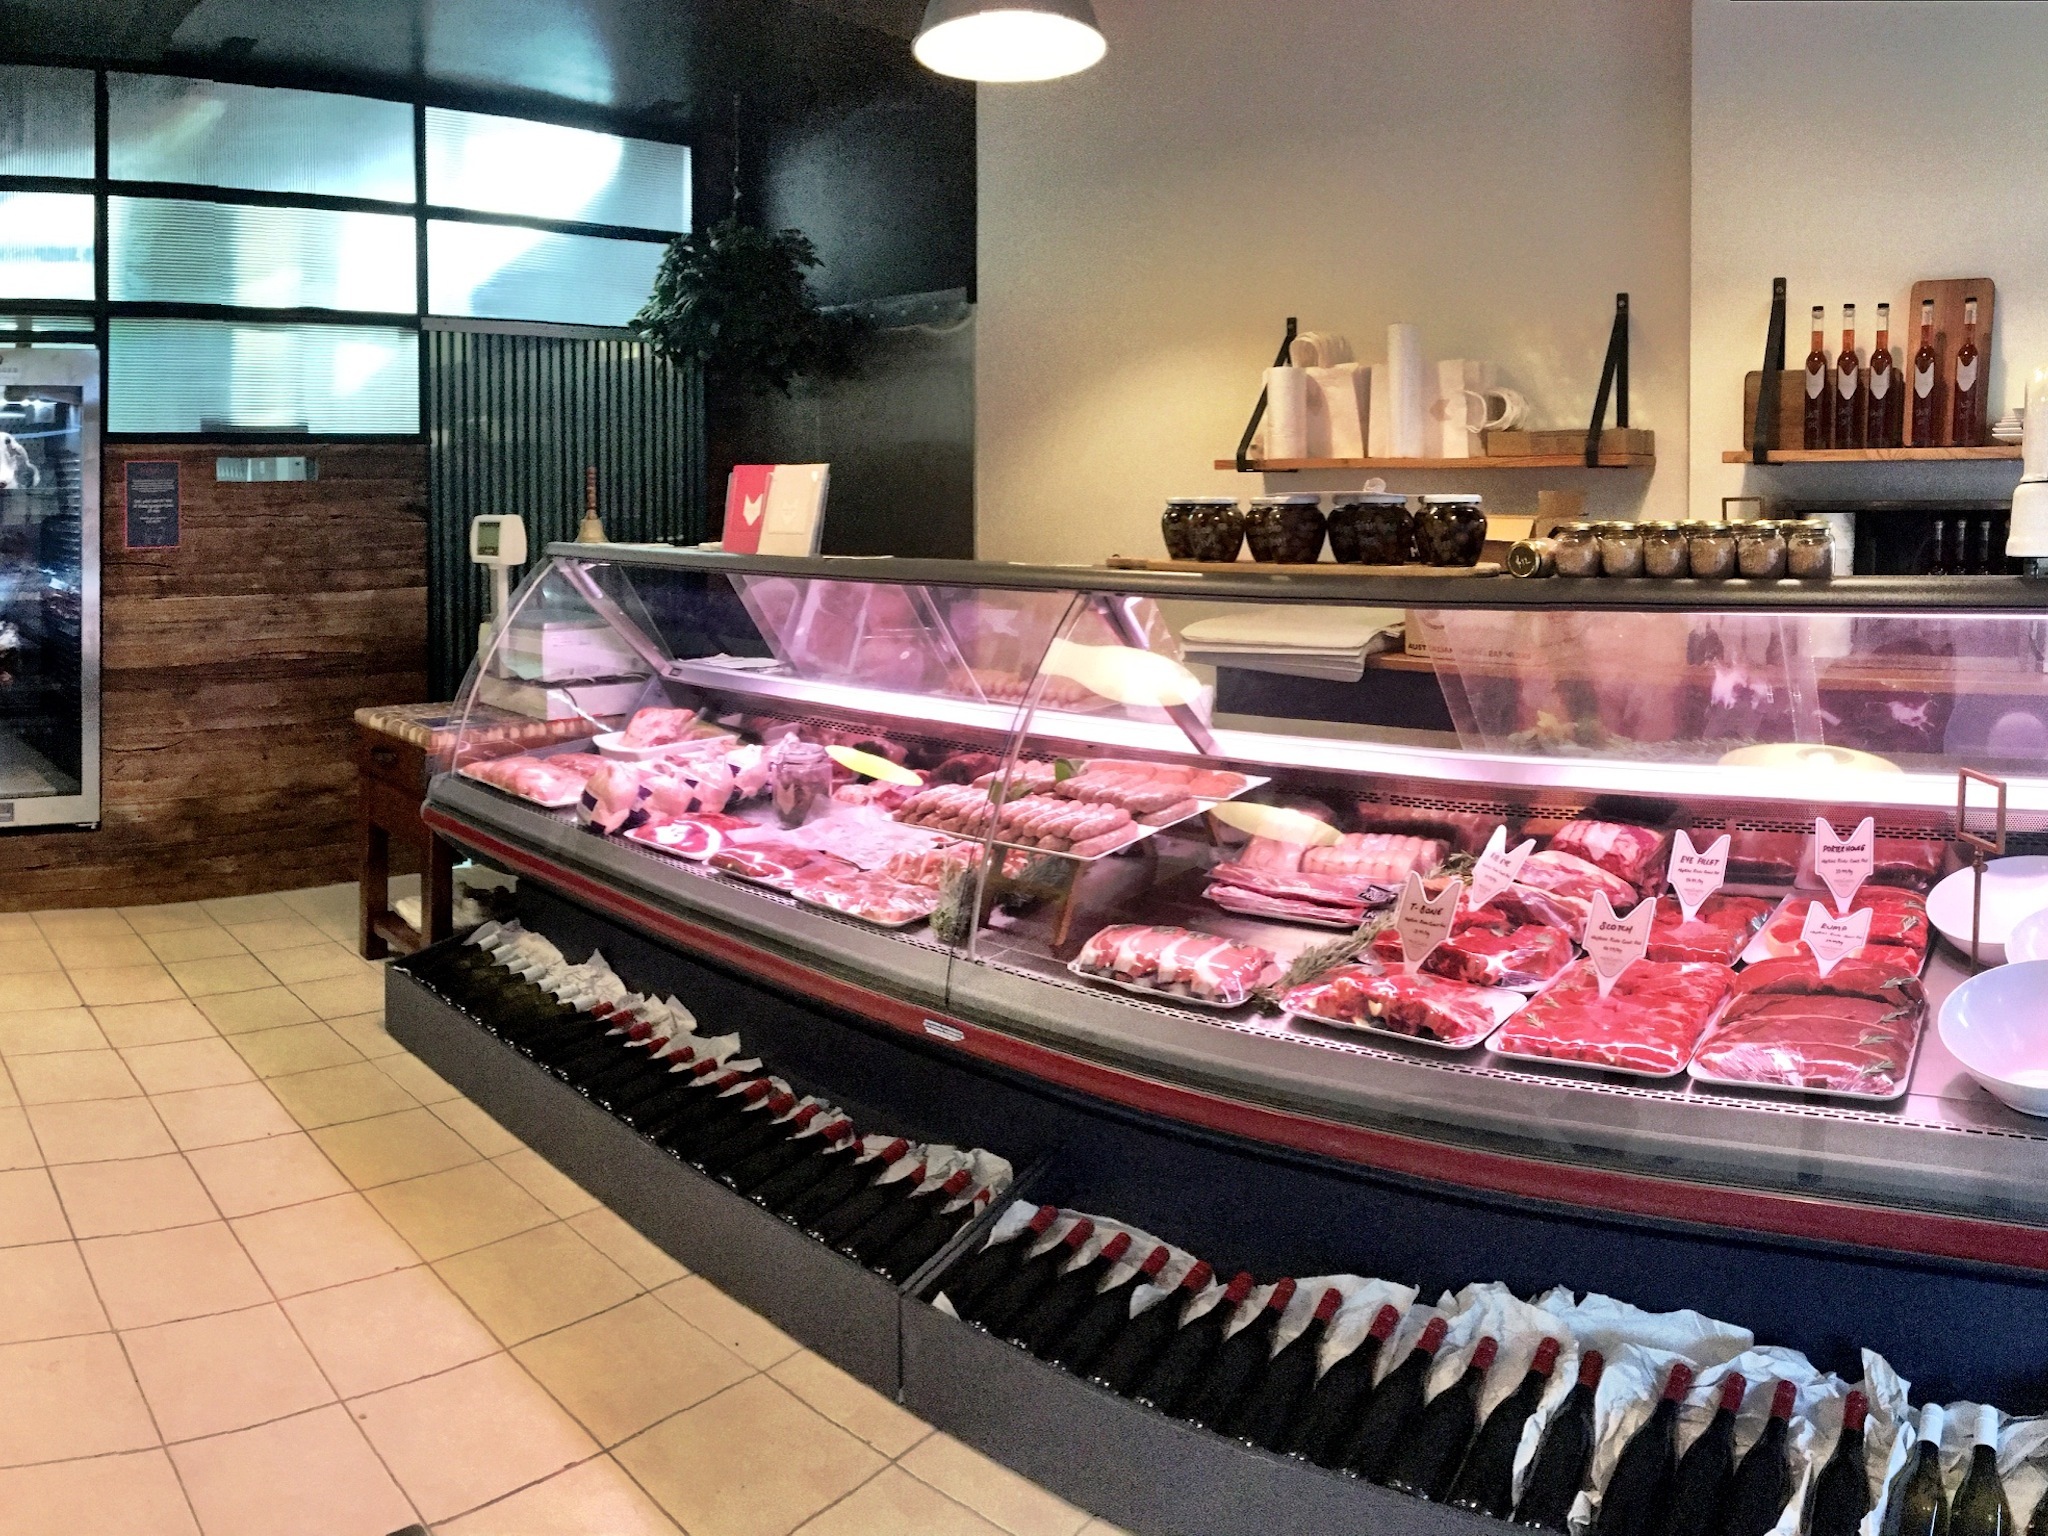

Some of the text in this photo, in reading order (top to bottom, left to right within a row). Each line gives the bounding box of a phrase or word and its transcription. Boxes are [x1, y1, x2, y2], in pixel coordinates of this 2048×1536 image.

[1680, 855, 1719, 866] EYE FILLET
[1599, 921, 1633, 934] SCOTCH
